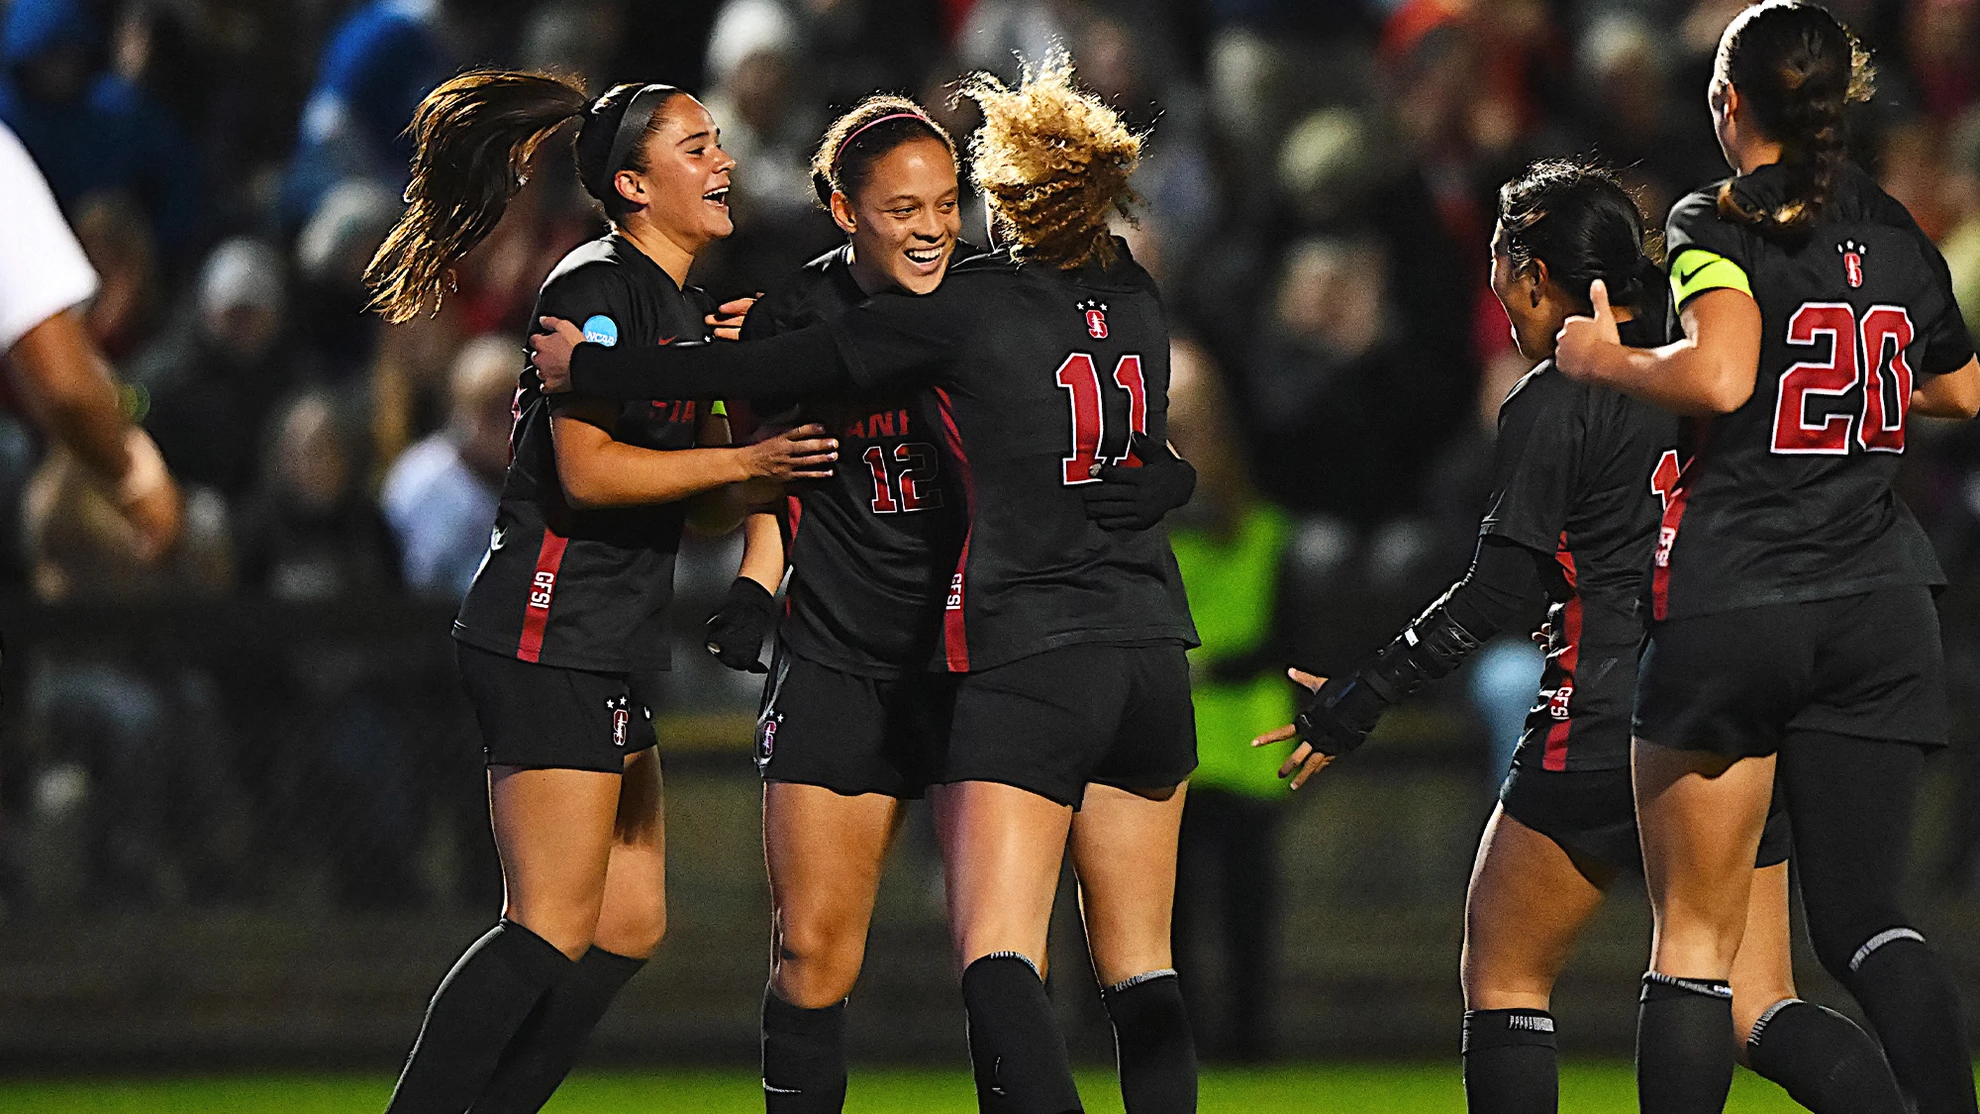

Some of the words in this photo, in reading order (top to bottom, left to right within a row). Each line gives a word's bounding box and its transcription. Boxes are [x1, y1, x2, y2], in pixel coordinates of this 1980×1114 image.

[585, 330, 616, 346] NCAA
[1085, 309, 1109, 339] S
[1770, 302, 1914, 455] 20
[1055, 352, 1148, 485] 11
[862, 442, 944, 513] 12
[529, 571, 555, 609] GFSI
[945, 572, 962, 610] GFSI
[1550, 686, 1573, 720] GFSI
